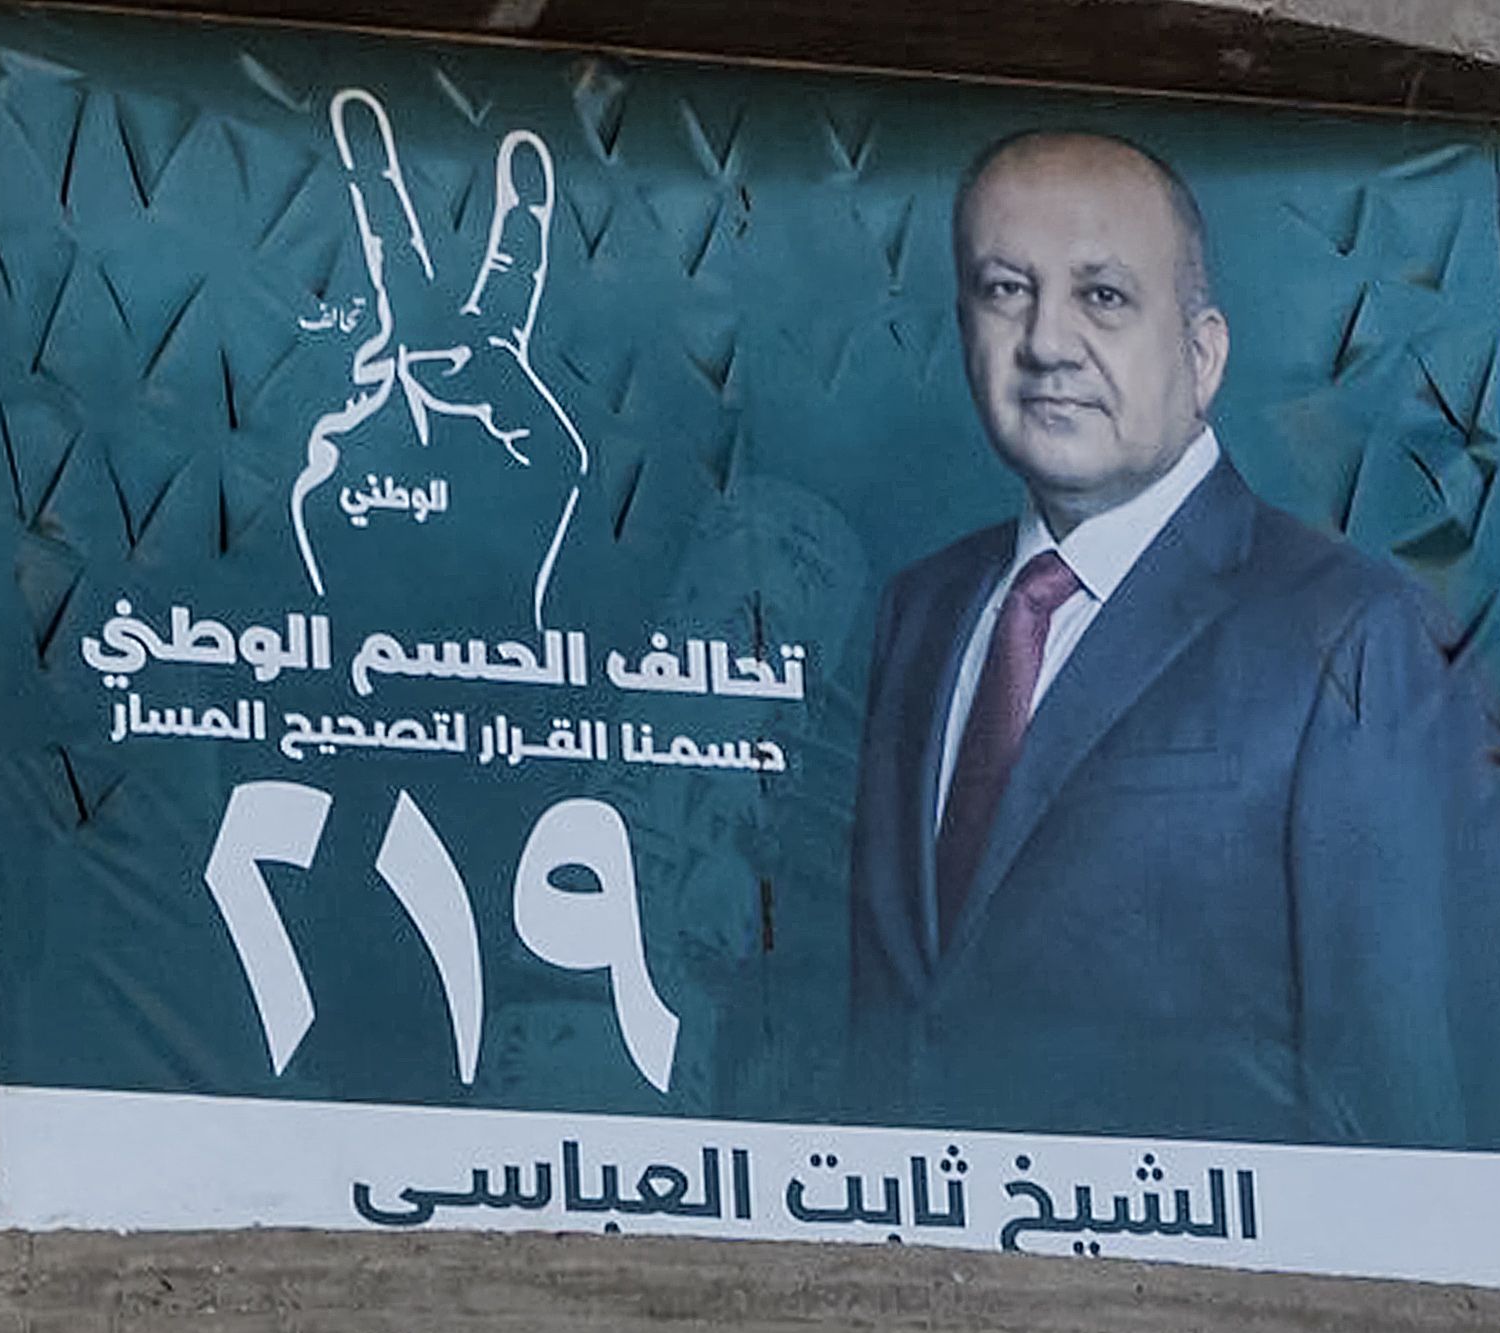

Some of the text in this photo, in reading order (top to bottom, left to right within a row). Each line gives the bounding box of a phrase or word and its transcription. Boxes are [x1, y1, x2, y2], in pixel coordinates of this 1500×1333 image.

[340, 474, 448, 527] الوطني
[81, 600, 805, 701] تحالف الحسم الوطني
[111, 693, 786, 773] حسمنا القرار لتصحيح المسار
[204, 780, 680, 1095] ٢١٩
[785, 1145, 969, 1245] ثابت
[1000, 1153, 1258, 1256] الشيخ
